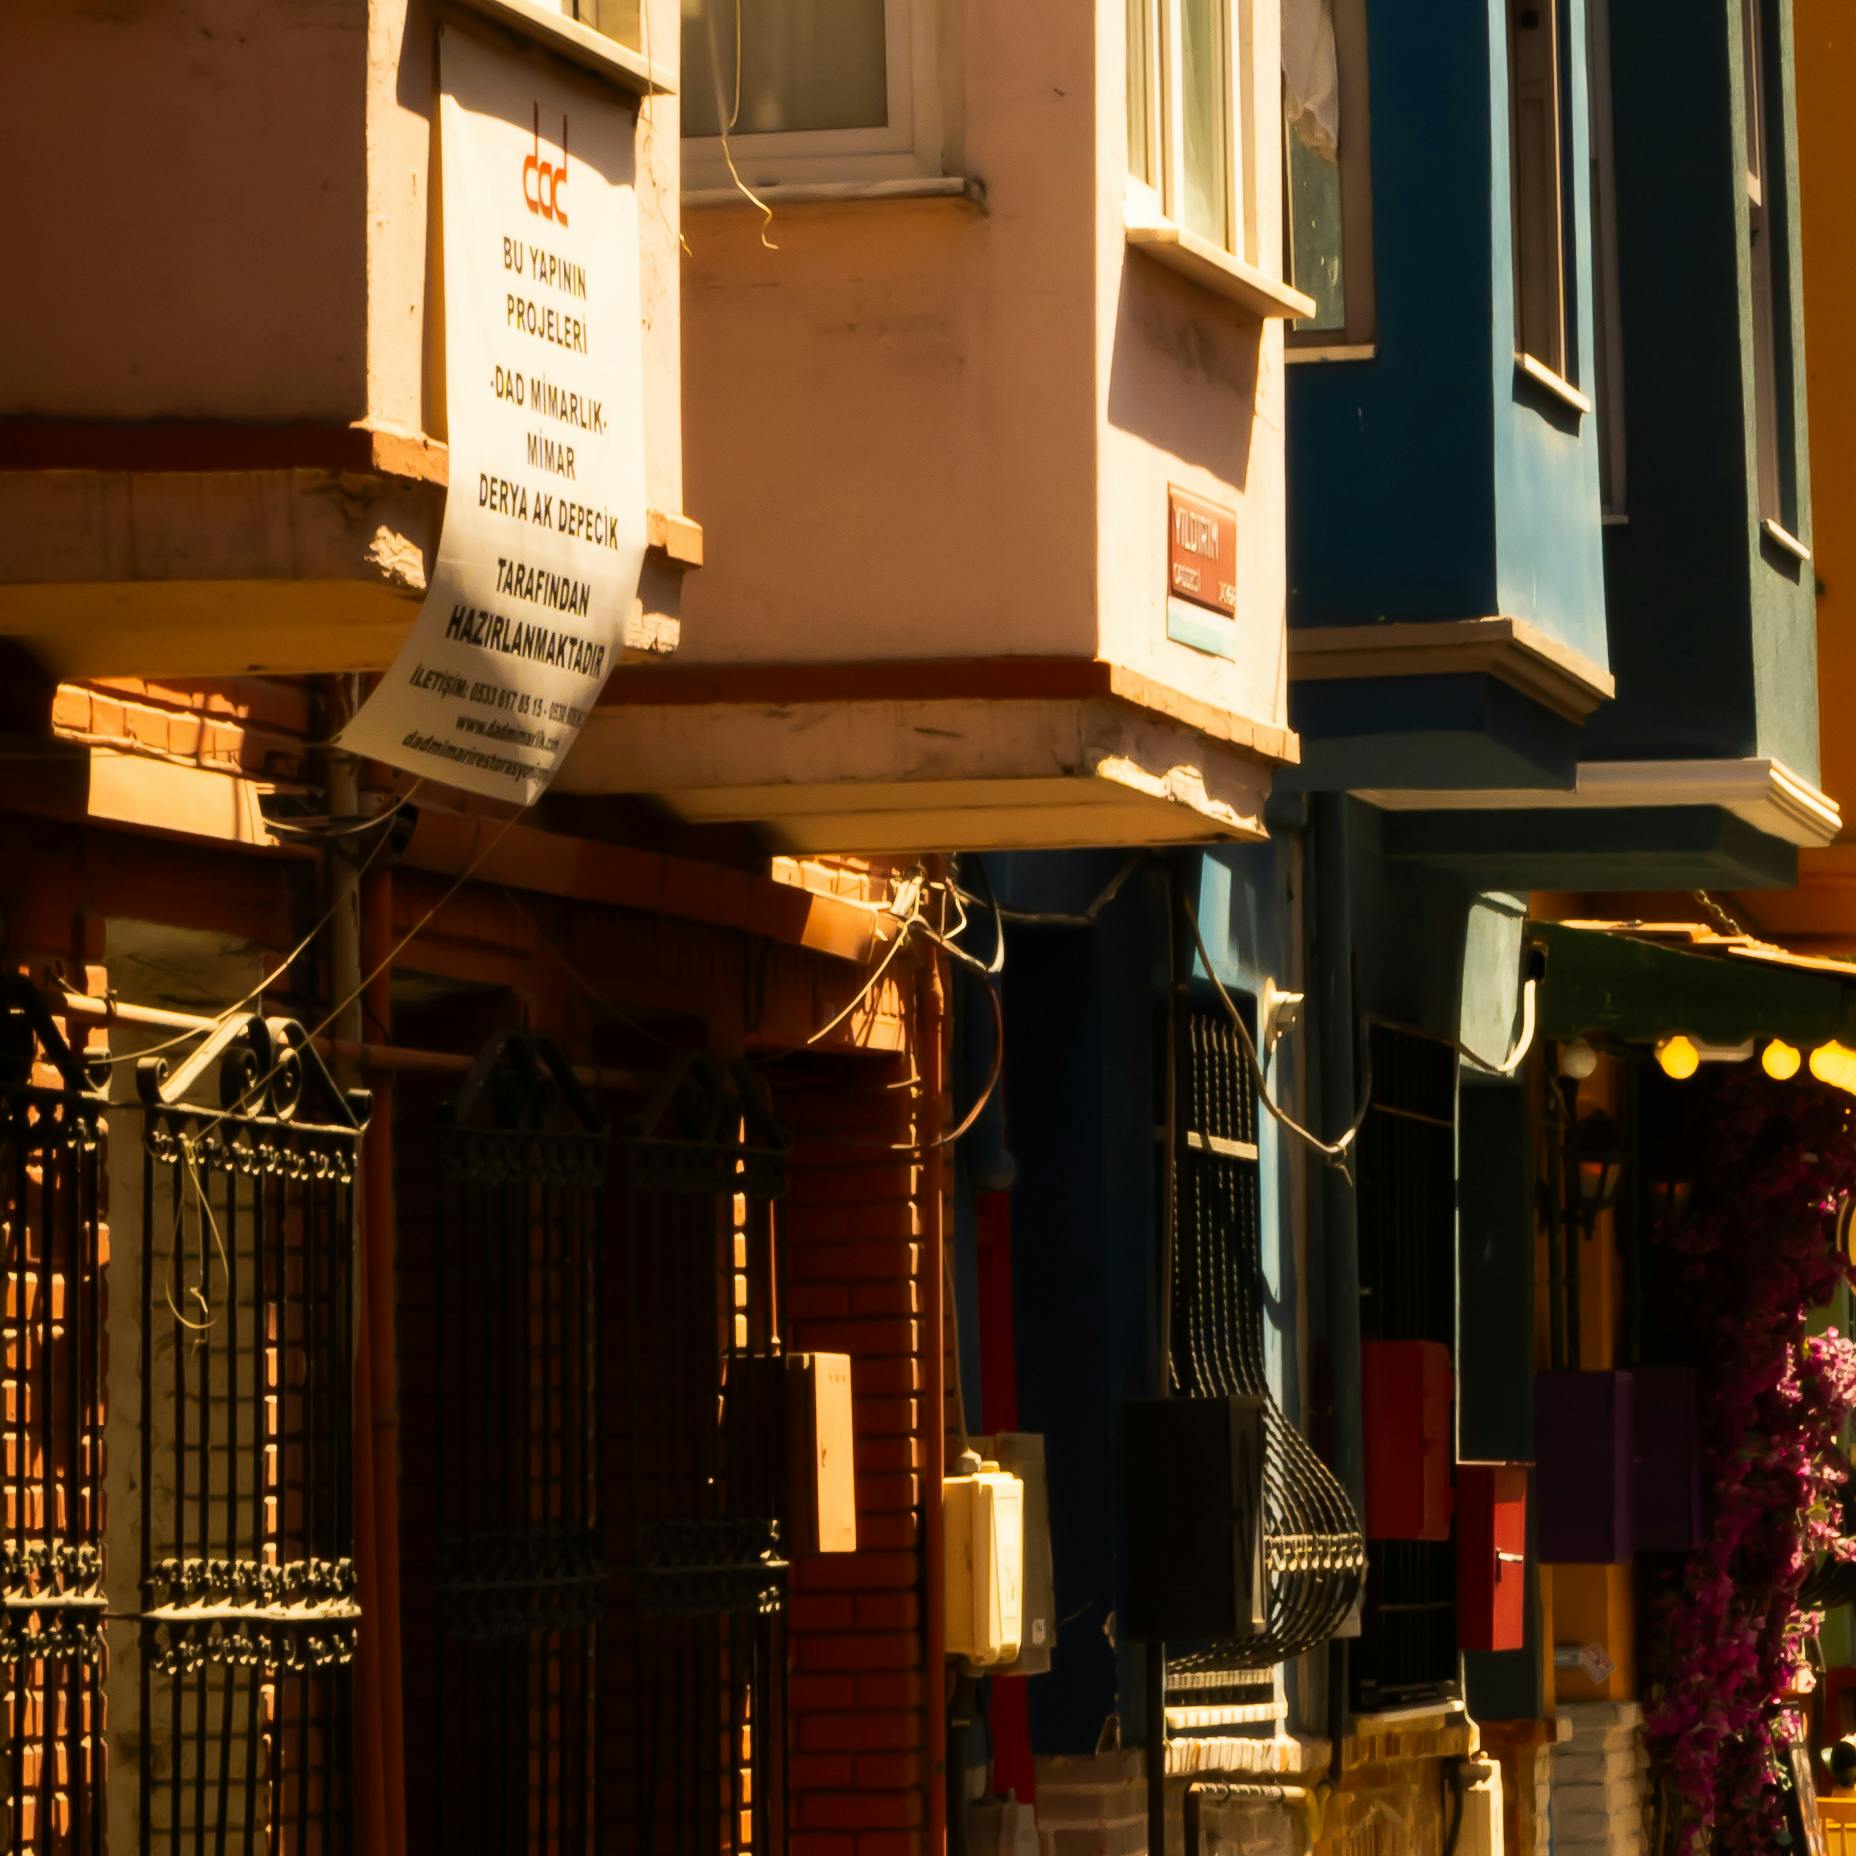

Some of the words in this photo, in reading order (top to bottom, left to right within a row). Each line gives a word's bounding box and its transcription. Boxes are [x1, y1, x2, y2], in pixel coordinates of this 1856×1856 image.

[503, 236, 523, 275] BU
[529, 245, 587, 301] YAPININ
[507, 293, 588, 355] PROJELERİ
[527, 427, 576, 481] MİMAR
[479, 472, 528, 521] DERYA
[532, 491, 553, 530] AK
[496, 556, 591, 618] TARAFINDAN
[445, 604, 605, 680] HAZIRLANMAKTADIR
